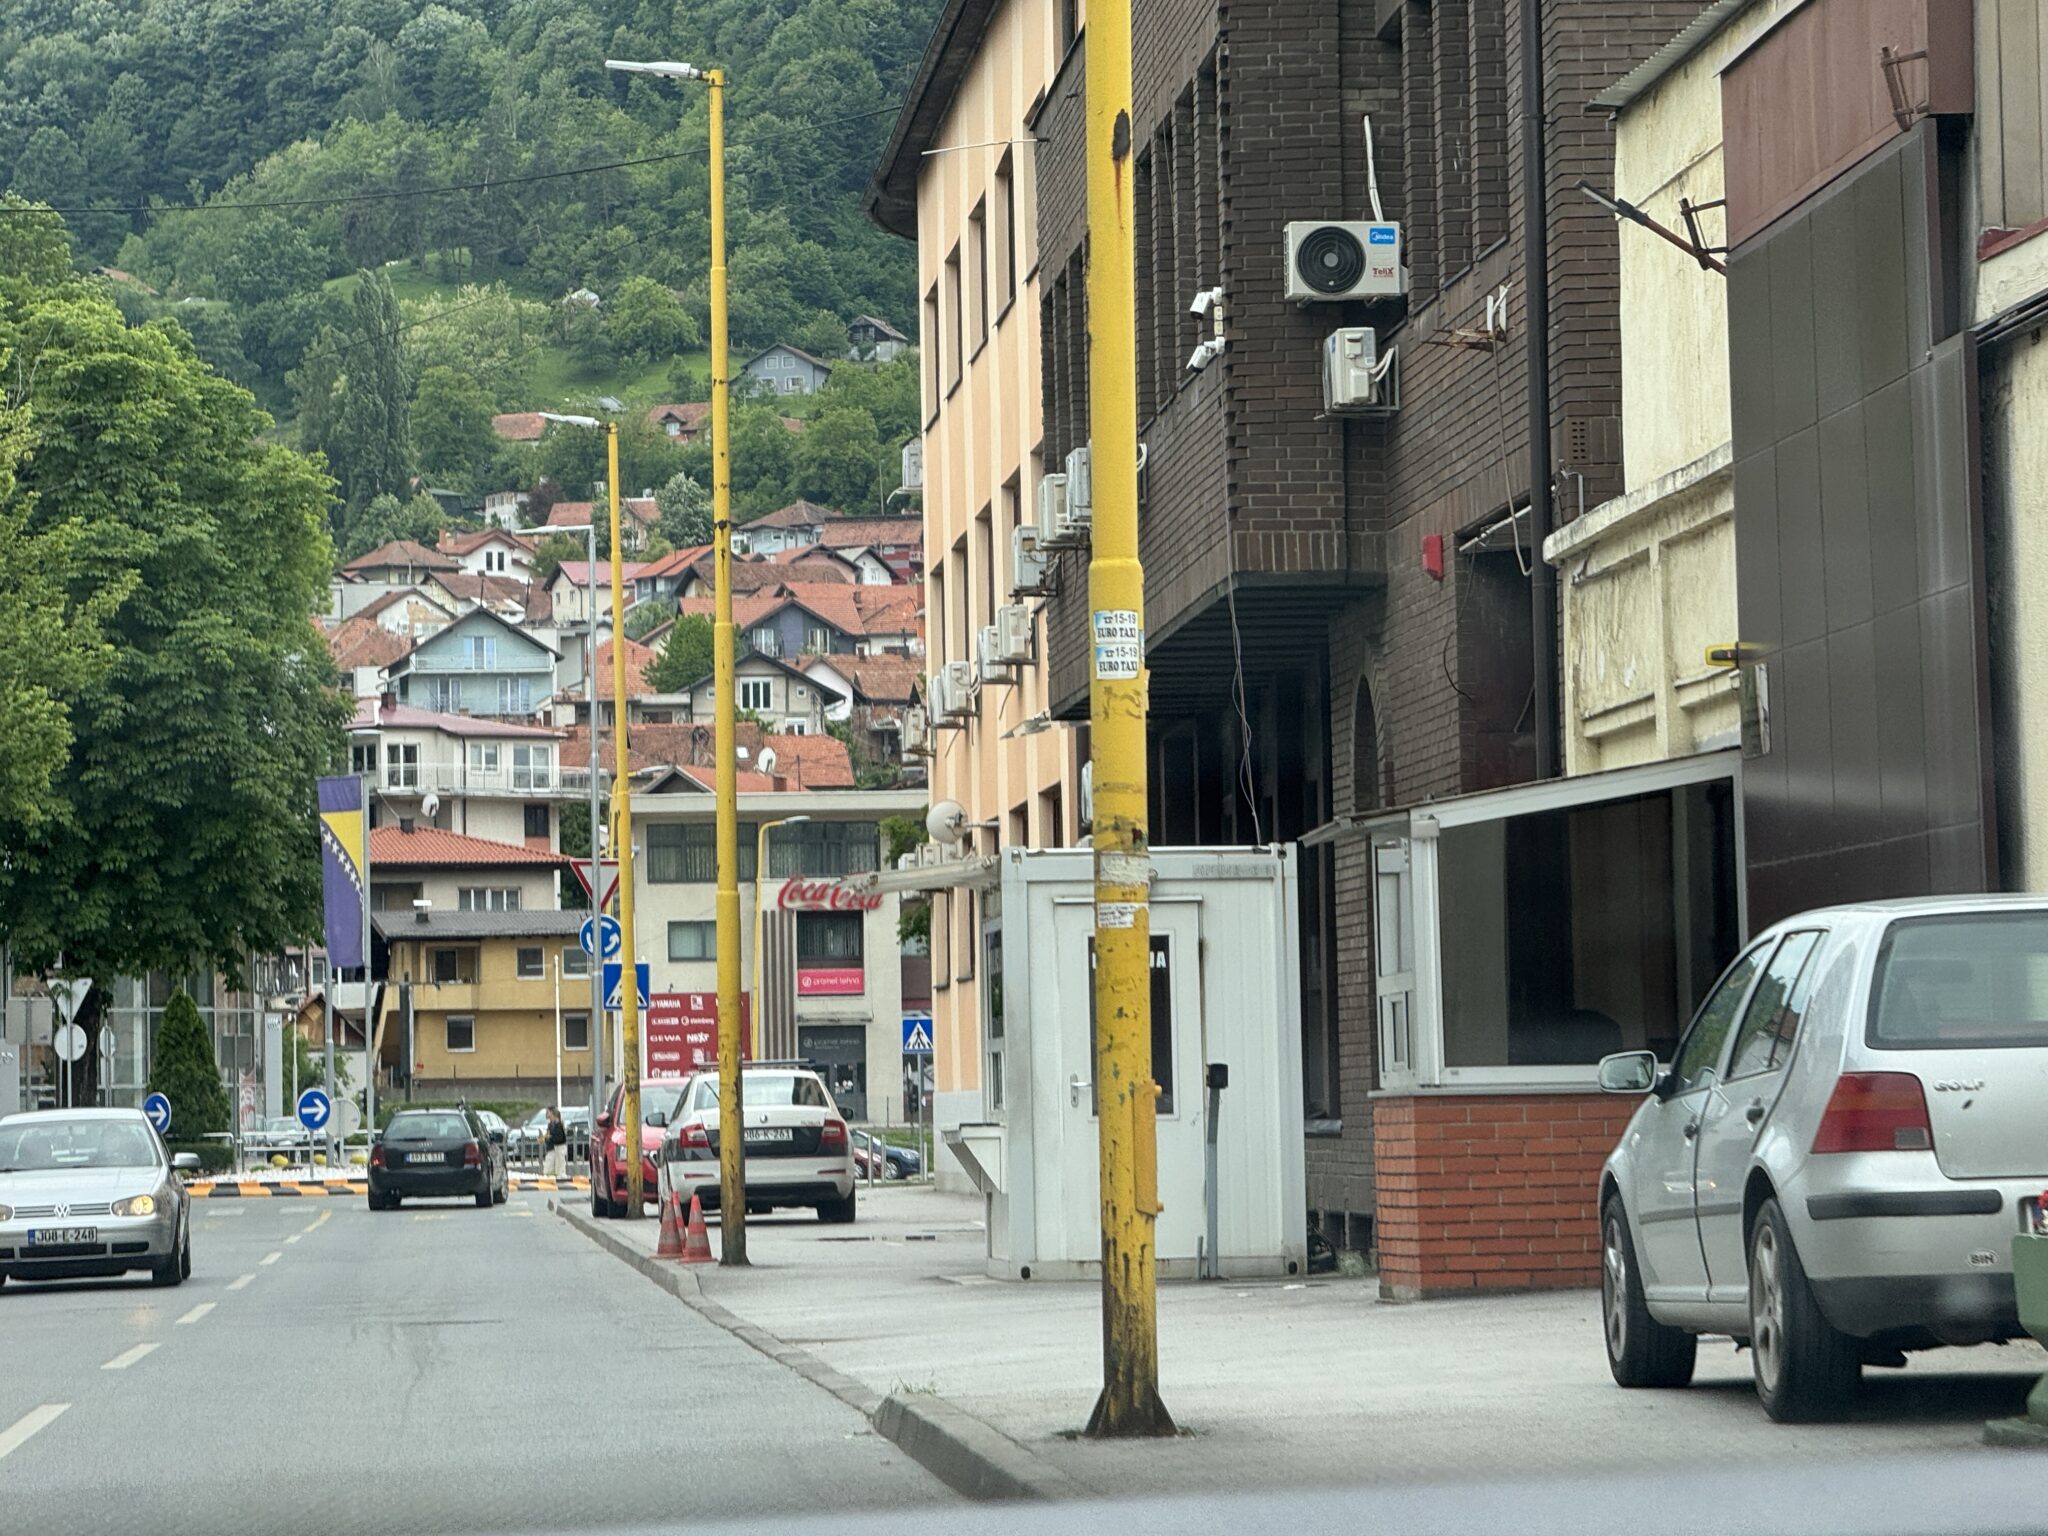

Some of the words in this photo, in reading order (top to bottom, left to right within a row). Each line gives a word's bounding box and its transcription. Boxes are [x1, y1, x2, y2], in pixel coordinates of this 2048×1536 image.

[1115, 613, 1136, 624] 15-19
[1097, 627, 1117, 638] EURO
[1119, 628, 1136, 637] TAXI
[1116, 647, 1138, 658] 15-19
[1099, 661, 1119, 672] EURO
[1121, 661, 1138, 671] TAXI
[657, 1000, 681, 1009] YAMAHA
